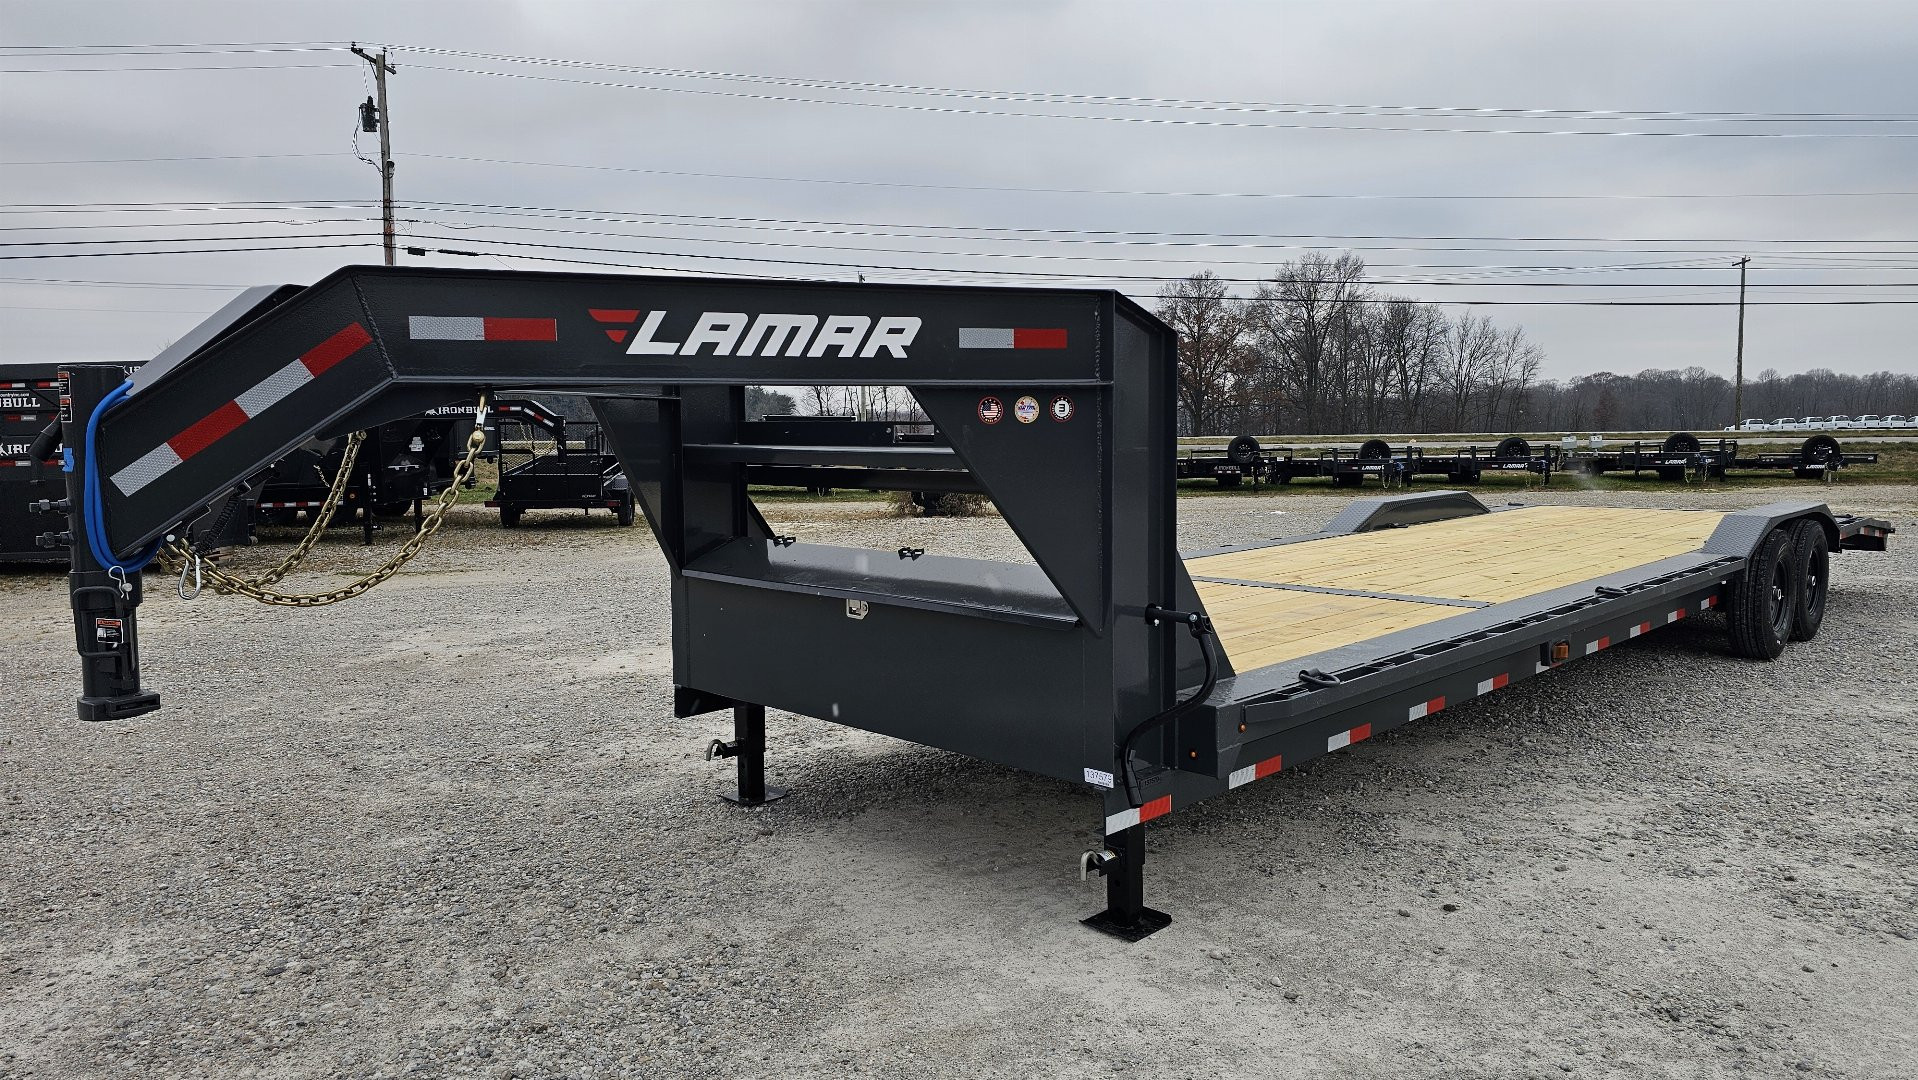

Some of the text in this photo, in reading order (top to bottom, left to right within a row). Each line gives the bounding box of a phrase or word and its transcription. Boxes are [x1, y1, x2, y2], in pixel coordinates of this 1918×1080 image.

[625, 310, 923, 359] LAMAR
[0, 397, 41, 408] BULL
[438, 406, 494, 415] IRONBUL
[1058, 403, 1066, 413] 3
